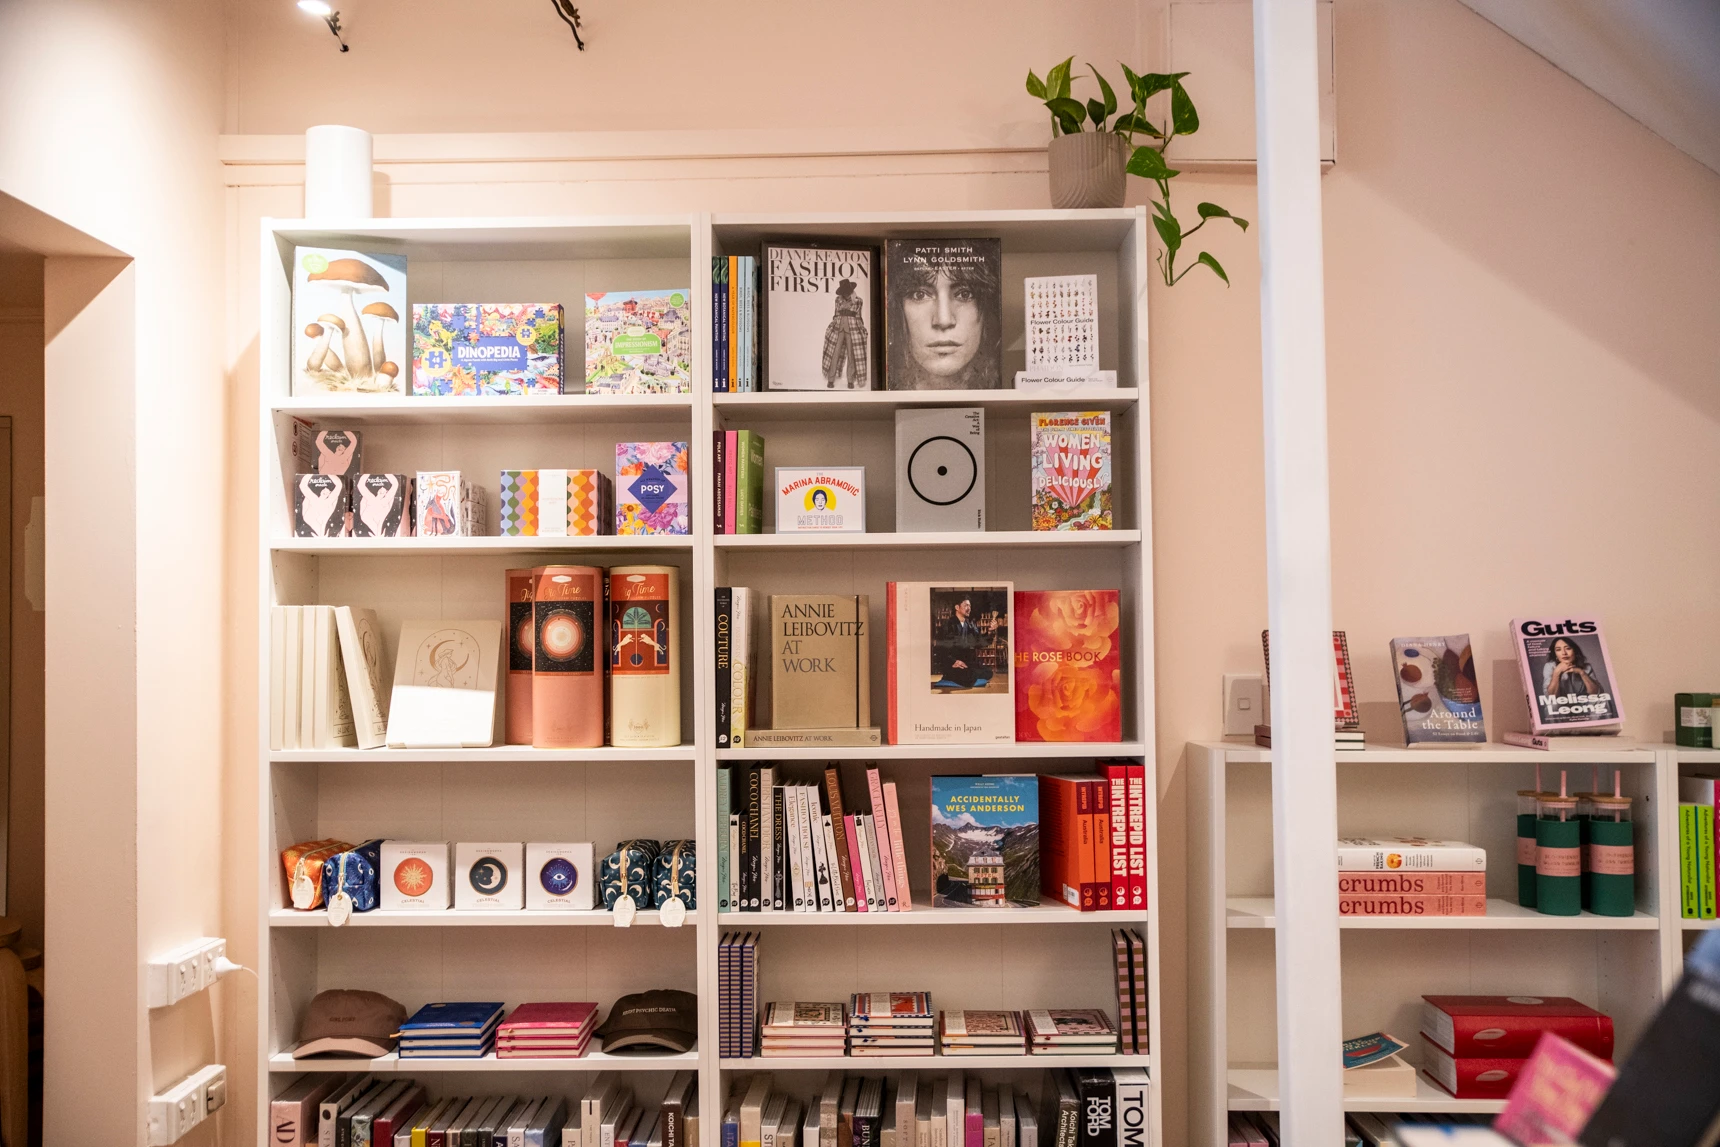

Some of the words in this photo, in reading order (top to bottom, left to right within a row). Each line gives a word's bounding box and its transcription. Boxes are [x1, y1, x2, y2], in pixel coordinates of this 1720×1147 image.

[769, 249, 811, 261] DIANE
[816, 250, 869, 263] KEATON
[903, 256, 927, 264] LYNN
[931, 255, 985, 263] GOLDSMITH
[769, 260, 868, 279] FASHION
[769, 276, 835, 293] FIRST
[458, 346, 520, 358] DINOPEDIA
[1038, 418, 1079, 427] FLORENCE
[1081, 416, 1105, 426] GIVEN
[1043, 434, 1100, 449] WOMEN
[1042, 452, 1103, 470] LIVING
[782, 477, 813, 496] MARINA
[1039, 476, 1104, 489] DELICIOUSLY
[797, 515, 843, 525] METHOD
[557, 583, 581, 595] Time
[632, 583, 655, 594] Time
[781, 604, 835, 618] ANNIE
[783, 622, 864, 636] LEIBOVITZ
[1520, 620, 1598, 636] Guts
[718, 614, 728, 668] COUTURE
[781, 640, 802, 654] AT
[782, 658, 836, 673] WORK
[1015, 652, 1029, 662] HE
[1033, 652, 1062, 662] ROSE
[1066, 652, 1101, 661] BOOK
[732, 662, 743, 714] COLOUR
[1538, 693, 1611, 706] Melissa
[1430, 707, 1476, 718] Around
[1547, 703, 1607, 715] Leong
[964, 724, 982, 733] Japan
[1422, 719, 1441, 730] the
[1444, 719, 1478, 729] Table
[1532, 738, 1543, 746] Guts
[720, 772, 728, 806] AUDREY
[750, 772, 759, 800] COCO
[826, 772, 837, 799] LOUIS
[870, 771, 880, 799] GRACE
[762, 772, 770, 830] CHRISTIAN
[750, 802, 759, 839] CHANEL
[831, 801, 845, 840] VUITTON
[874, 803, 885, 829] KELLY
[1111, 786, 1126, 845] INTREPID
[1129, 785, 1143, 845] INTREPID
[762, 832, 770, 850] DIOR
[894, 840, 903, 859] little
[1113, 848, 1127, 876] LIST
[1130, 848, 1143, 876] LIST
[897, 862, 906, 888] things
[1339, 874, 1424, 892] crumbs
[1339, 896, 1424, 914] crumbs
[1087, 1097, 1100, 1136] FORD
[1100, 1096, 1111, 1129] TOM
[1124, 1091, 1144, 1147] TOM
[276, 1115, 295, 1143] AD
[1069, 1111, 1078, 1134] Koichi
[862, 1125, 870, 1147] BUN
